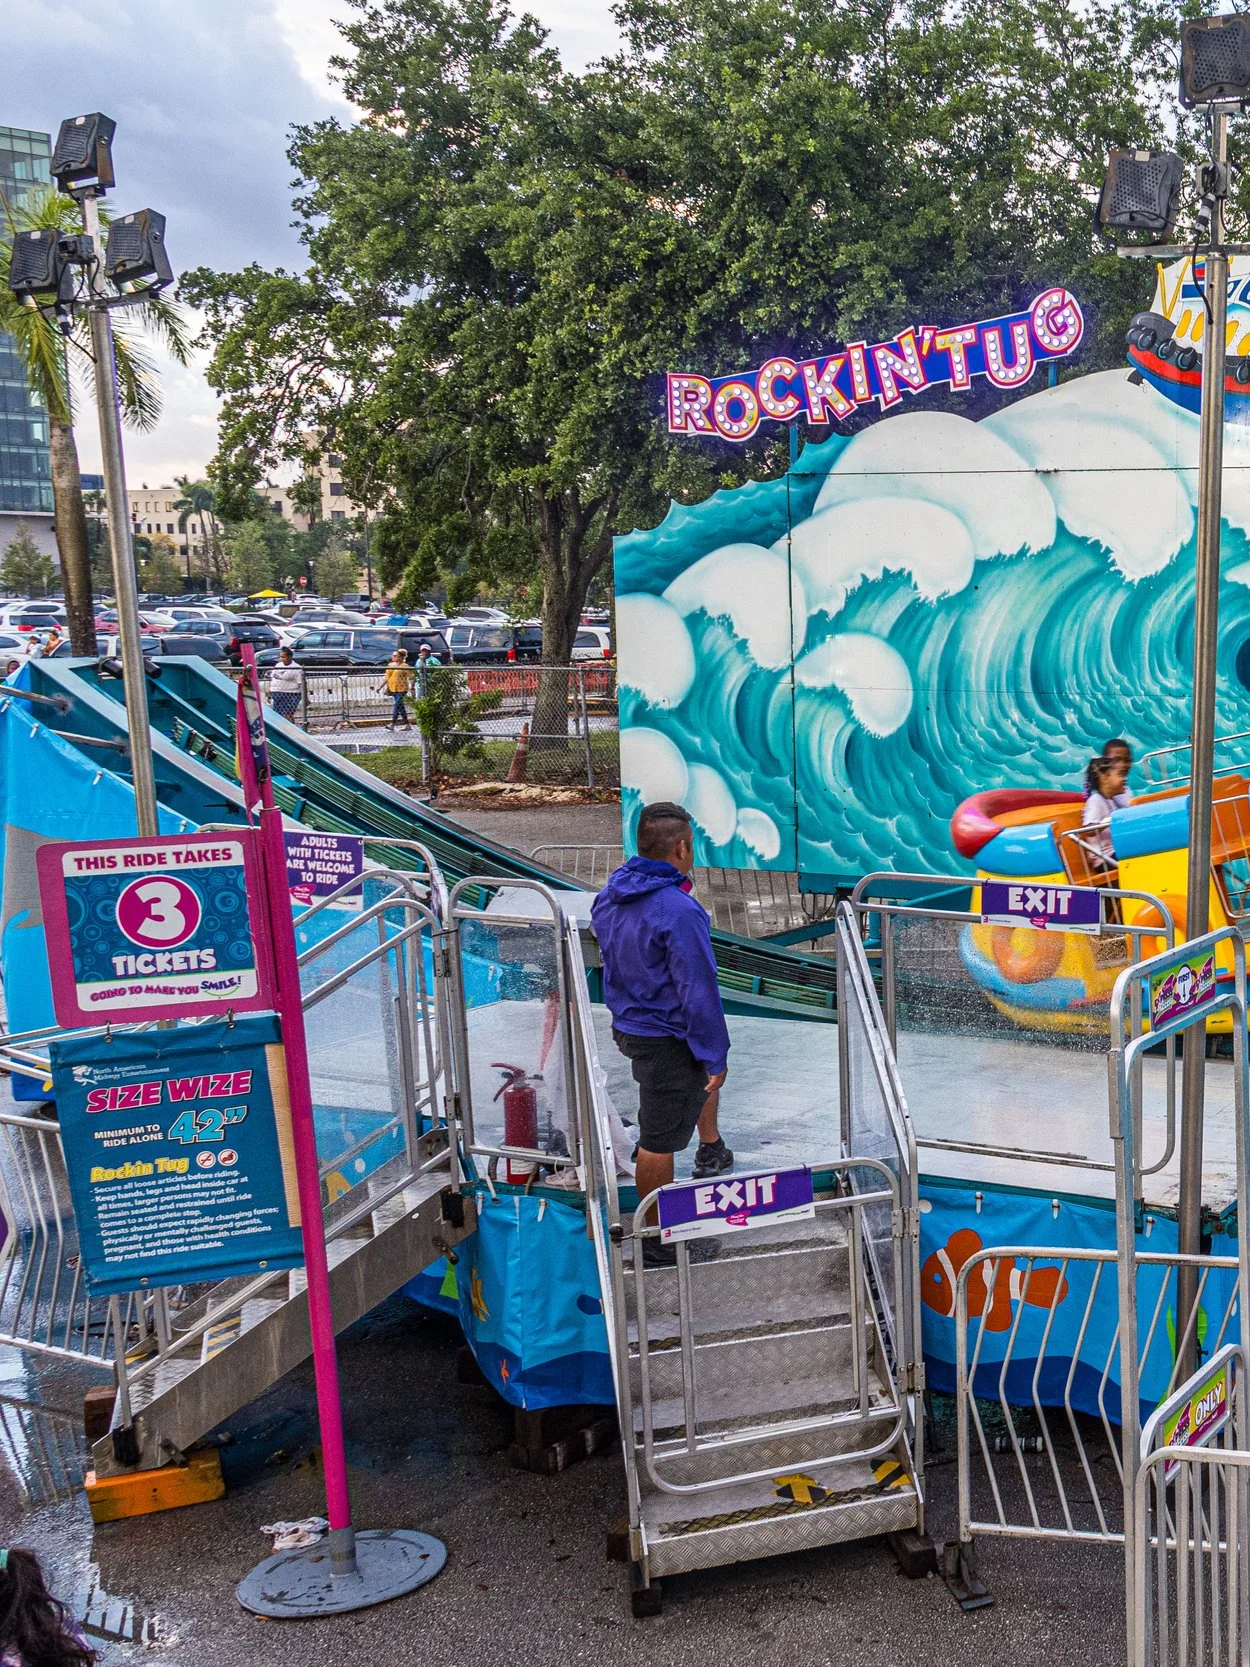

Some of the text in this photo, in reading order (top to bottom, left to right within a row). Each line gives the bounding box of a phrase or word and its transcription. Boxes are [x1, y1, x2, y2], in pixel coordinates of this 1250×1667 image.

[301, 836, 338, 848] ADULTS
[74, 848, 232, 871] THIS RIDE TAKES
[286, 858, 355, 874] ARE WELCOME
[287, 847, 352, 862] WITH TICKETS
[301, 872, 339, 885] TO RIDE
[134, 881, 186, 941] 3
[1008, 887, 1073, 916] EXIT
[111, 948, 217, 978] TICKETS
[90, 976, 242, 1002] GOING TO MAKE YOU SMILE!
[86, 1070, 253, 1113] SIZE WIZE
[94, 1124, 161, 1140] MINIMUM TO
[103, 1132, 164, 1148] RIDE ALONE
[90, 1157, 190, 1183] Rockin Tug
[94, 1170, 240, 1194] Secure all loose articles before riding.
[95, 1194, 117, 1202] Keep
[118, 1191, 145, 1199] hands,
[146, 1187, 163, 1196] legs
[164, 1184, 180, 1192] and
[181, 1182, 201, 1190] head
[202, 1179, 226, 1188] inside
[97, 1203, 108, 1211] all
[108, 1200, 134, 1209] times,
[134, 1197, 159, 1206] larger
[160, 1193, 192, 1203] persons
[193, 1190, 209, 1198] may
[211, 1188, 225, 1196] not
[98, 1193, 253, 1219] Remain seated and restrained until ride
[694, 1174, 778, 1215] EXIT
[100, 1220, 127, 1228] comes
[144, 1211, 182, 1222] complete
[183, 1209, 202, 1217] stop.
[100, 1228, 129, 1236] Guests
[130, 1222, 158, 1232] should
[159, 1219, 186, 1229] expect
[186, 1216, 214, 1225] rapidly
[215, 1210, 253, 1221] changing
[102, 1233, 143, 1246] physically
[154, 1227, 189, 1238] mentally
[190, 1222, 234, 1234] challenged
[145, 1239, 161, 1248] and
[162, 1237, 185, 1245] those
[185, 1234, 204, 1242] with
[204, 1230, 230, 1240] health
[230, 1225, 272, 1236] conditions
[105, 1240, 225, 1263] may not find this ride suitable.
[1194, 1381, 1223, 1427] ONLY
